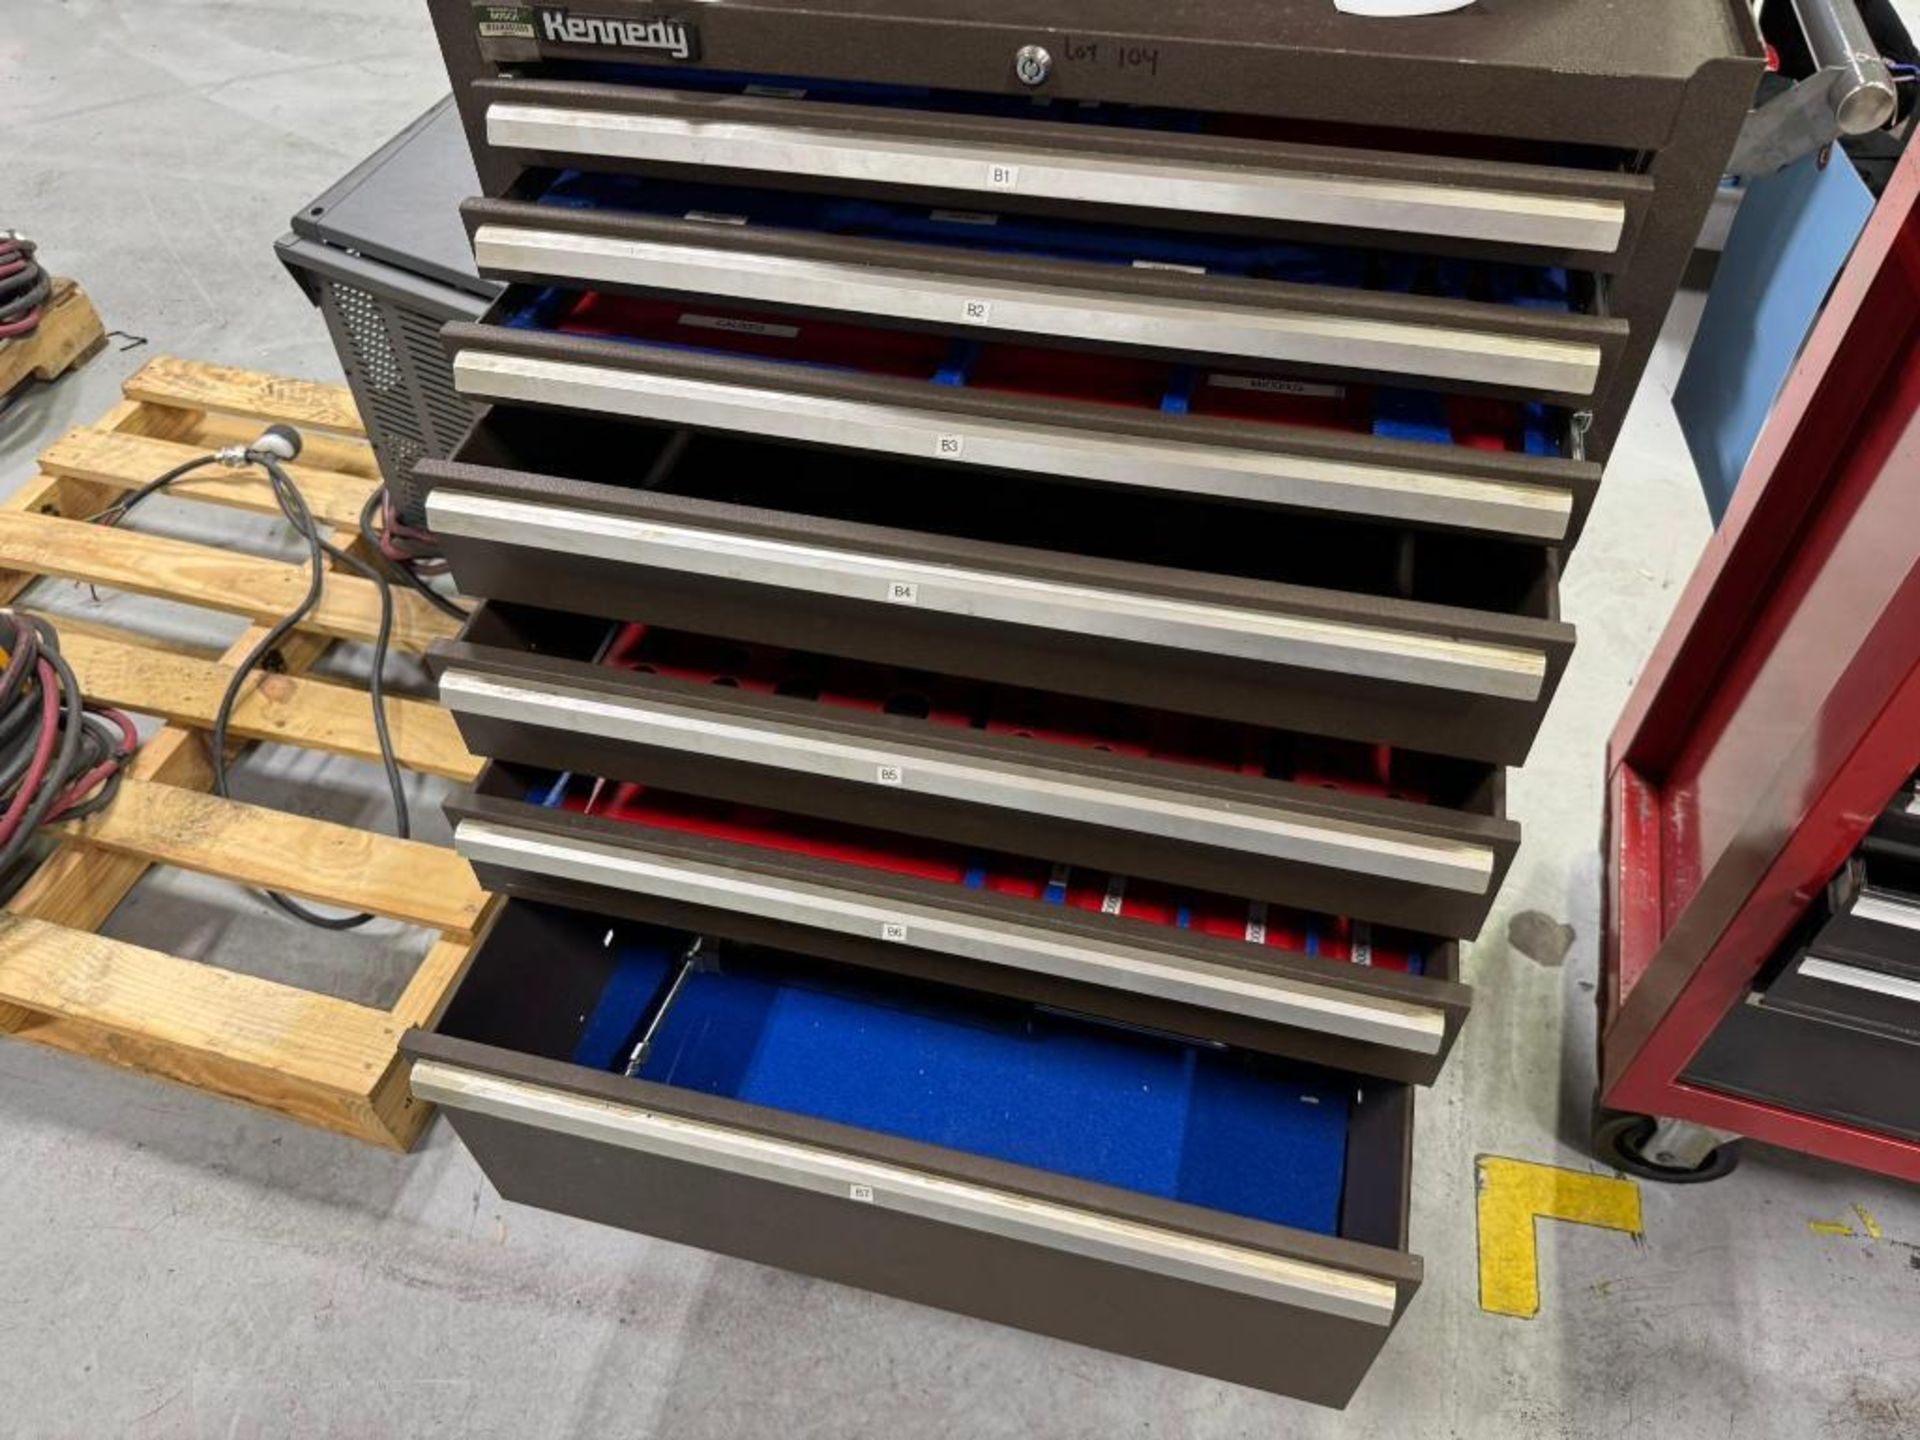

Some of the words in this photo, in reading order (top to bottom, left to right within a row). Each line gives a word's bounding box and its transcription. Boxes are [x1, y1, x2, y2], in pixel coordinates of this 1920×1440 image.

[542, 11, 688, 58] Kennedy
[1119, 47, 1159, 76] 104
[993, 168, 1009, 183] B1
[967, 303, 985, 317] B2
[941, 439, 958, 452] B3
[894, 585, 911, 598] B4
[881, 768, 898, 781] B5
[887, 926, 903, 938] B6
[855, 1187, 870, 1198] B7
